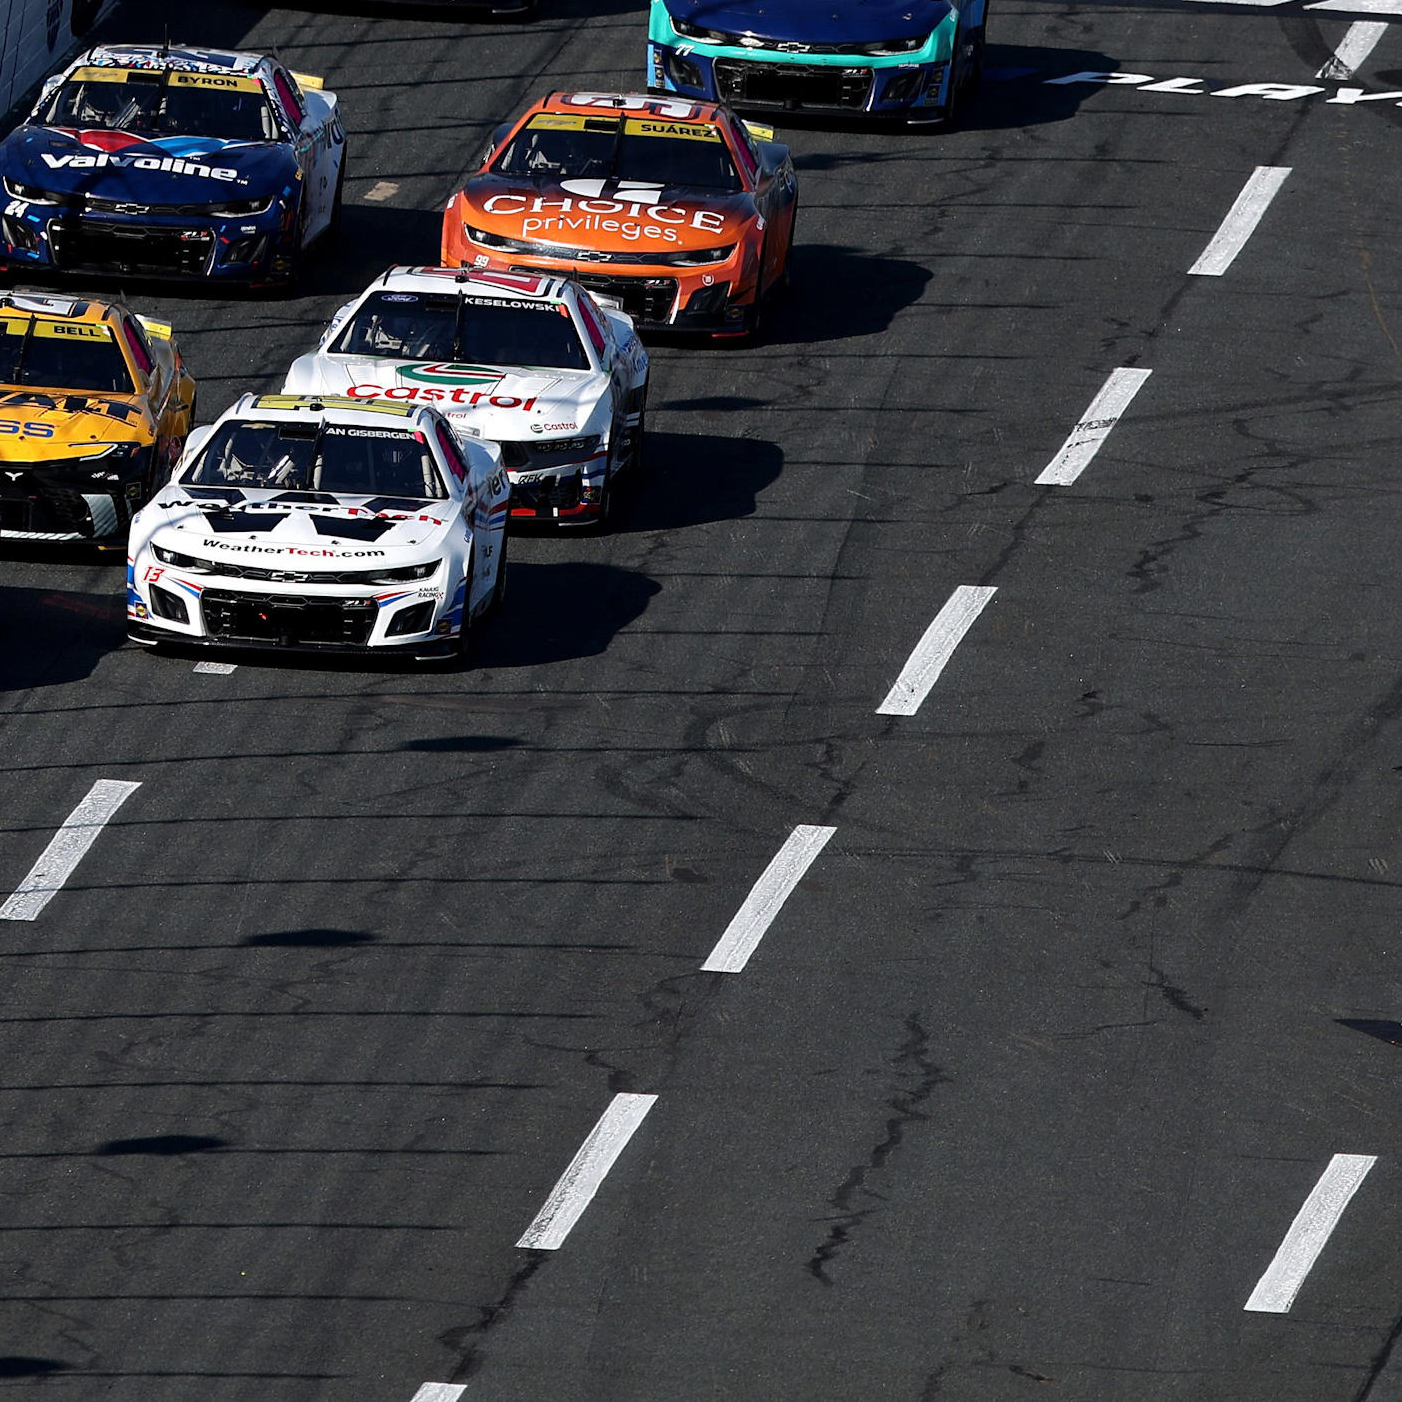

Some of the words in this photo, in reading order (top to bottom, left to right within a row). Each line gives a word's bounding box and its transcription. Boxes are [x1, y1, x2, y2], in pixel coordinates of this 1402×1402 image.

[177, 76, 238, 88] BYRON
[640, 121, 715, 138] SUÁREZ
[40, 153, 238, 182] Valvoline
[4, 200, 30, 218] 24
[483, 194, 725, 235] CHOICE
[522, 214, 684, 246] privileges.
[474, 253, 490, 268] 99
[464, 296, 560, 312] KESELOWSKI
[53, 325, 101, 338] BELL
[346, 384, 538, 412] Castrol
[325, 427, 347, 436] AN
[349, 428, 417, 441] GISBERGEN
[543, 422, 579, 431] Castrol
[201, 537, 386, 559] WeatherTech.com
[143, 565, 165, 582] 13
